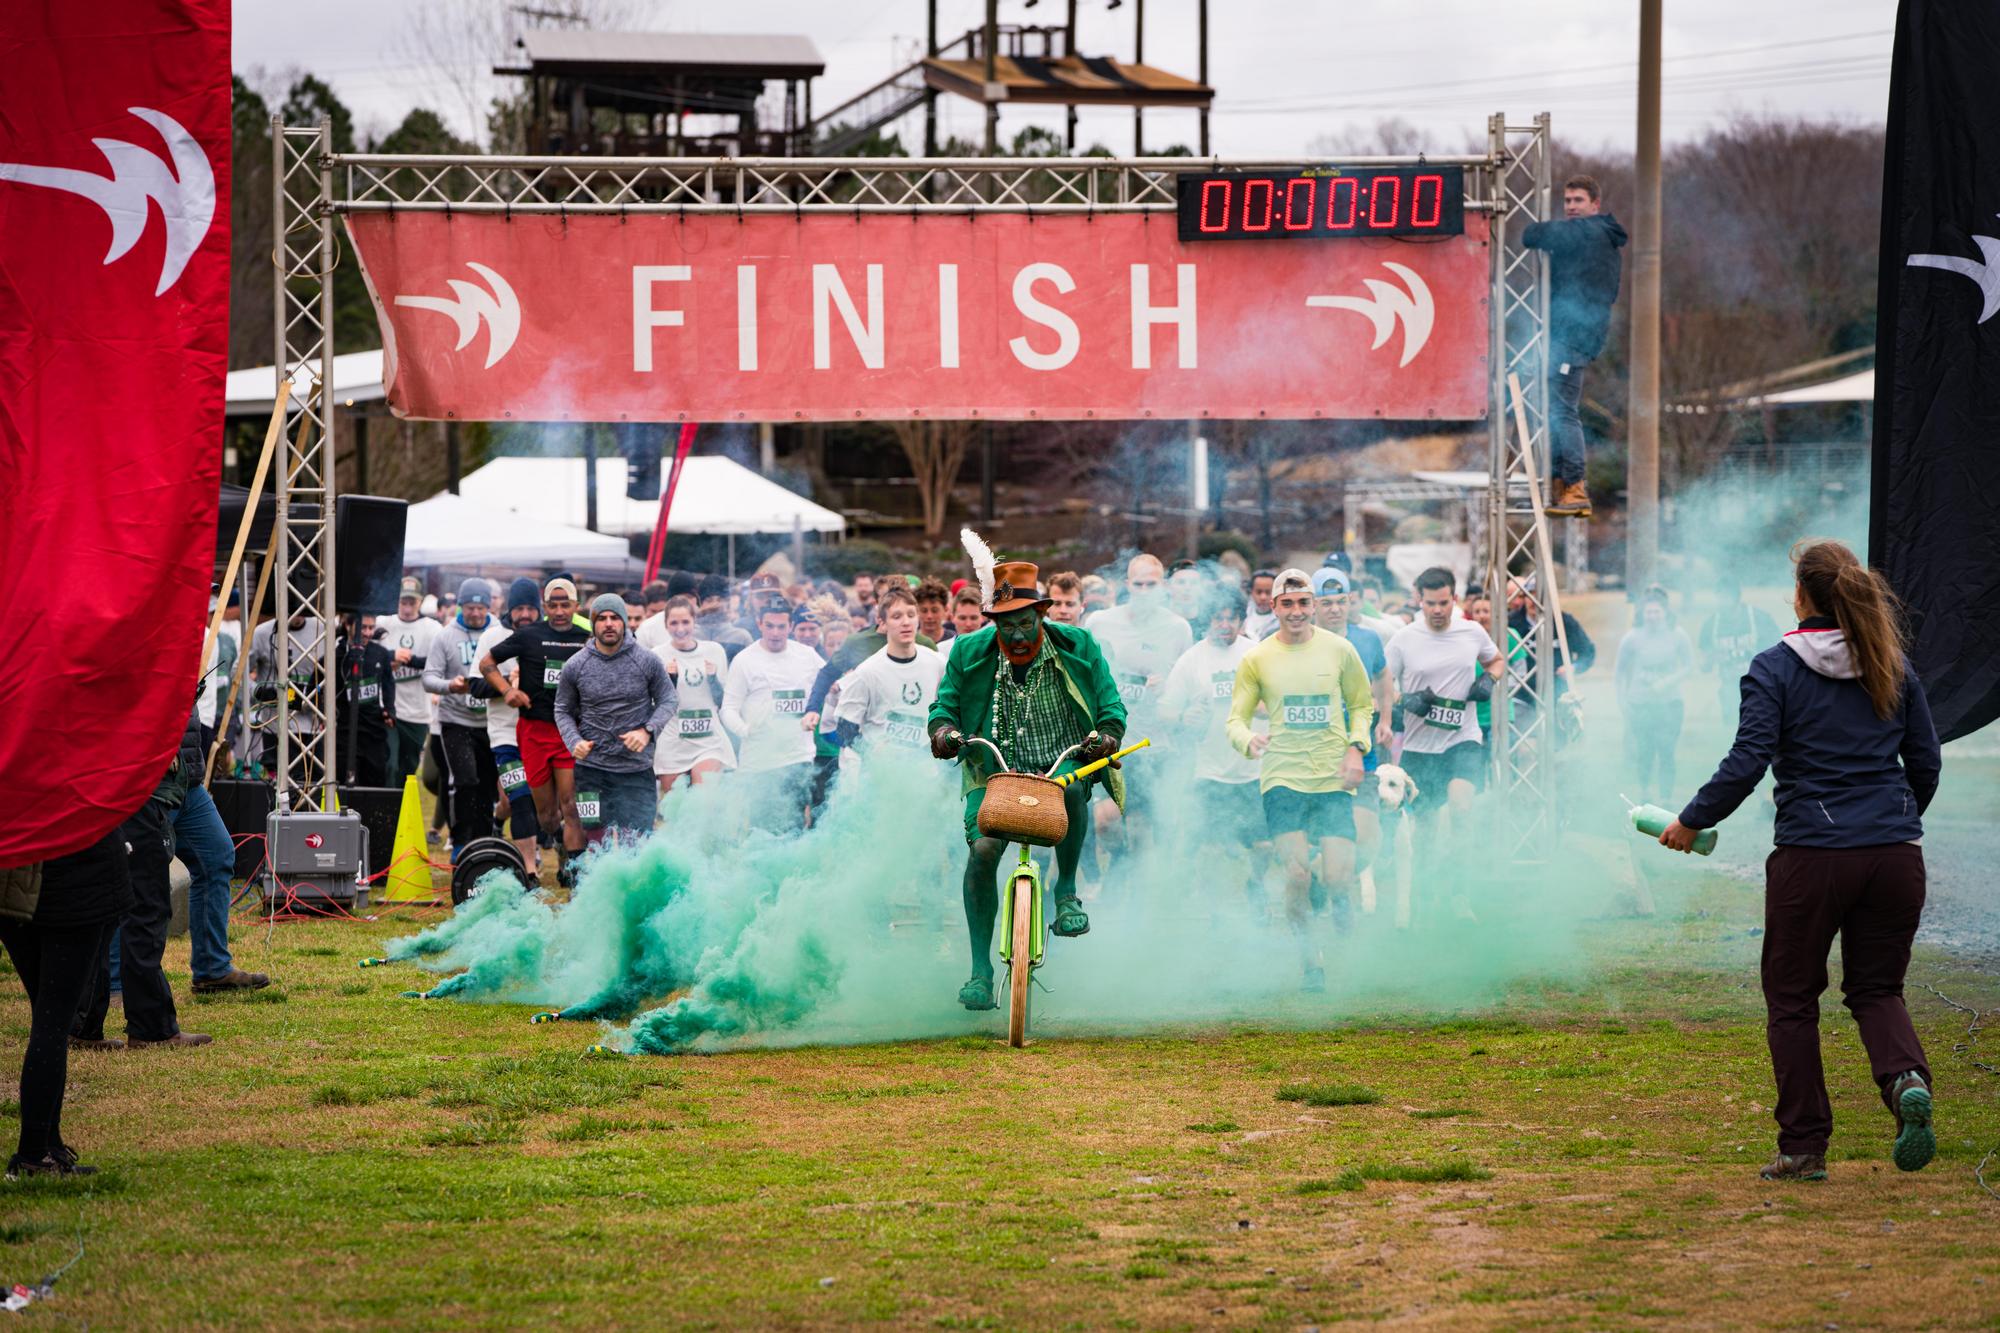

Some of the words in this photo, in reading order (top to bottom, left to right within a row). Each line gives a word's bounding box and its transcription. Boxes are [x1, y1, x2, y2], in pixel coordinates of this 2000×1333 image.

[1201, 175, 1443, 232] 00:00:00
[632, 262, 1198, 373] FINISH
[775, 700, 804, 713] 6201
[1288, 706, 1326, 722] 6439
[1429, 706, 1462, 725] 6193
[681, 719, 711, 732] 6387
[886, 722, 921, 741] 6270
[500, 768, 527, 788] 6267
